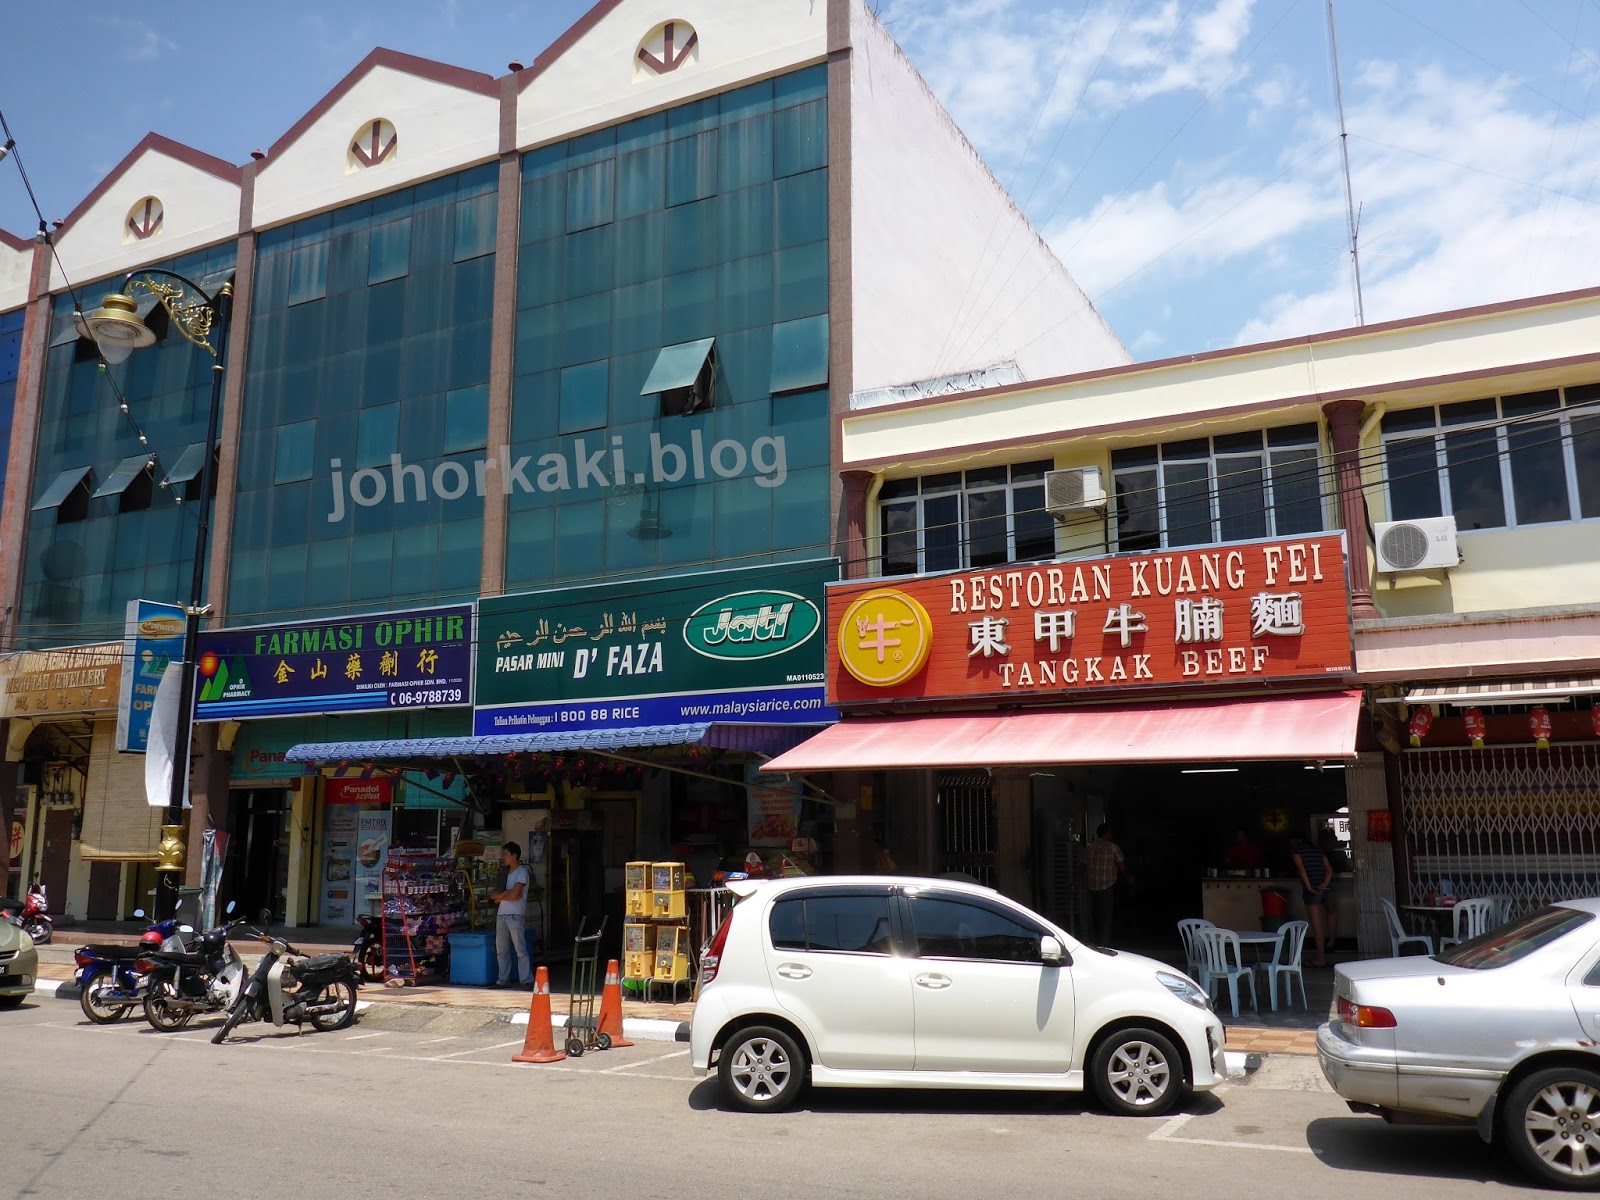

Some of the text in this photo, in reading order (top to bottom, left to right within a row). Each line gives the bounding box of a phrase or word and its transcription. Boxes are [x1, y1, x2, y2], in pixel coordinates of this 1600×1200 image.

[950, 543, 1324, 614] RESTORAN KUANG FEI
[703, 602, 795, 645] Jati
[967, 591, 1306, 658] 東甲牛腩麵
[255, 615, 464, 655] FARMASI OPHIR
[273, 648, 439, 684] 金山藥劑行
[495, 653, 534, 673] PASAR
[536, 651, 565, 669] MINI
[606, 641, 664, 677] FAZA
[999, 645, 1270, 687] TANGKAK BEEF
[51, 668, 108, 690] JEWELLERY
[222, 690, 251, 698] PHARMACY
[398, 689, 462, 705] 06-9788739
[560, 710, 586, 722] 800
[590, 708, 608, 720] 88
[612, 707, 640, 720] RICE
[680, 698, 822, 716] www.malaysiarice.com
[249, 748, 286, 763] Pana
[344, 785, 380, 793] Panadol
[360, 818, 388, 827] EMTRIX
